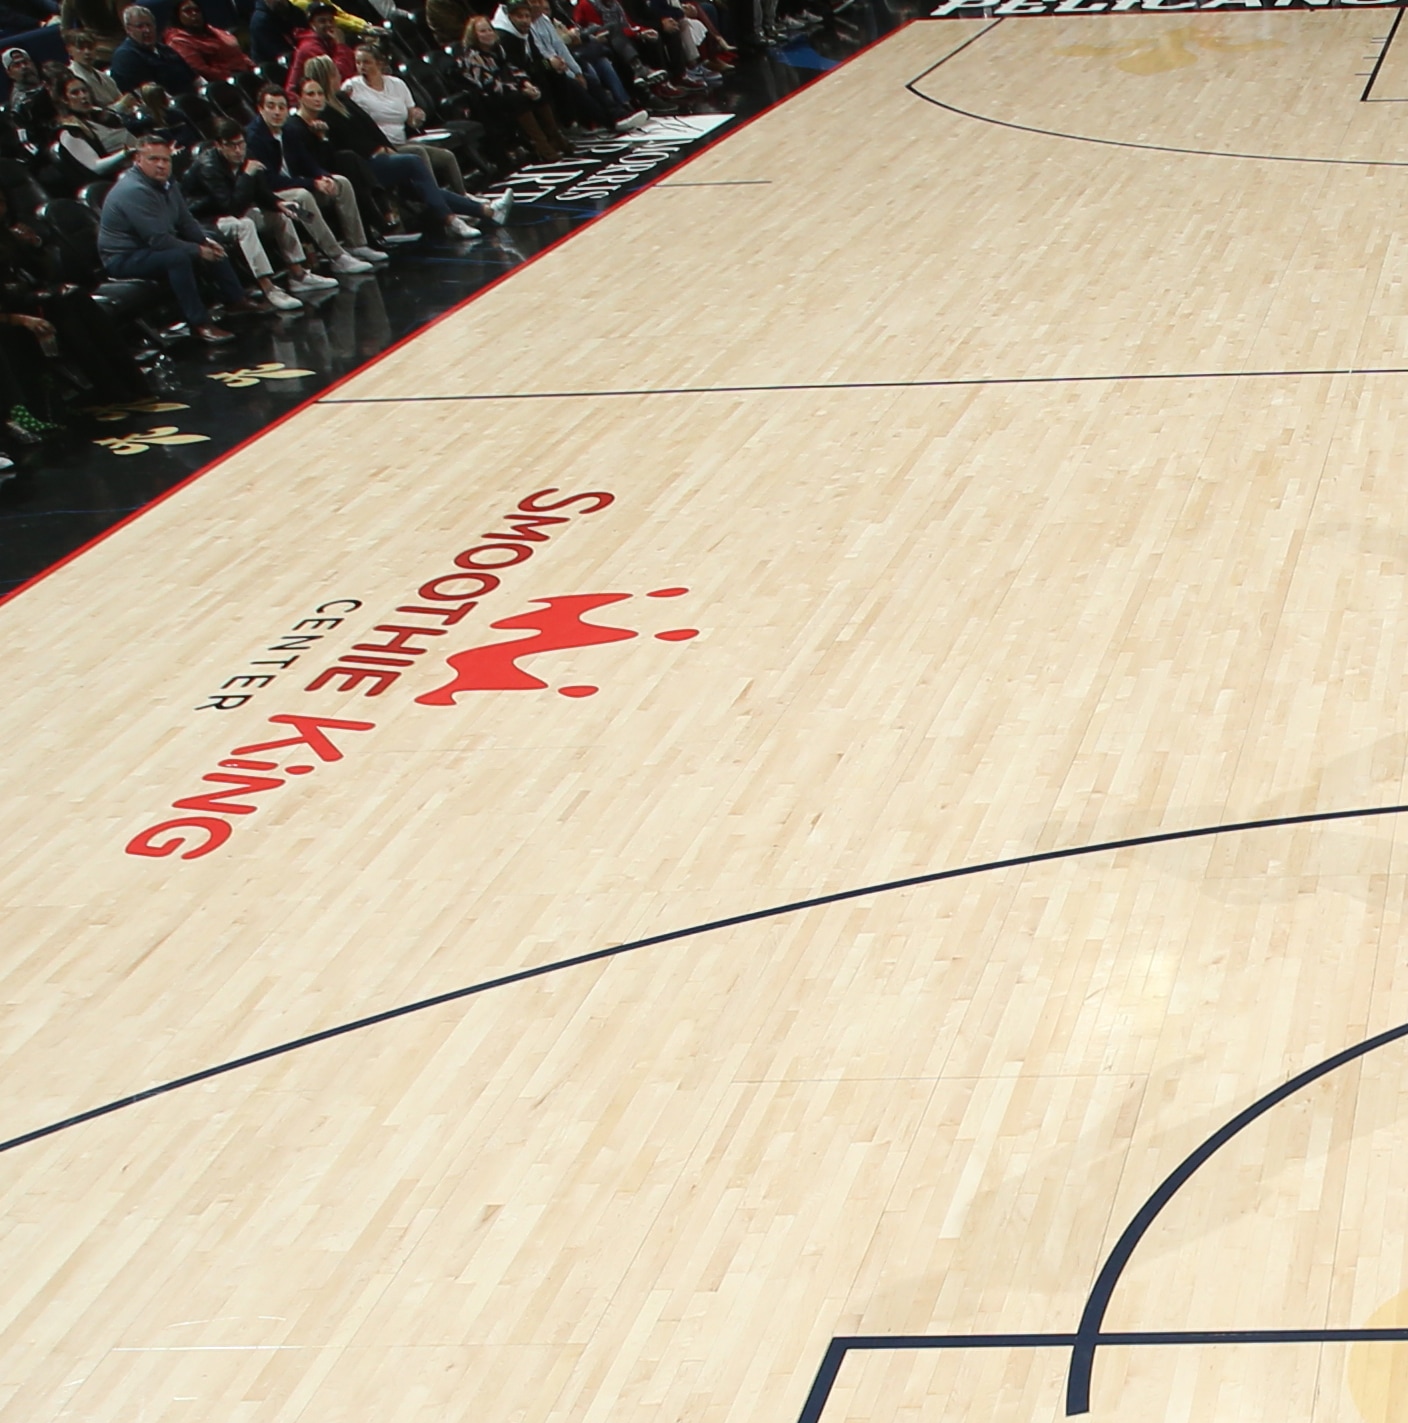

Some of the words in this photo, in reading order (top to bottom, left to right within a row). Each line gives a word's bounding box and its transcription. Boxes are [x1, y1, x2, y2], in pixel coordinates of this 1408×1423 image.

[930, 0, 1400, 16] PELICA
[304, 486, 616, 698] SMOOTHIE
[194, 598, 363, 712] CENTER
